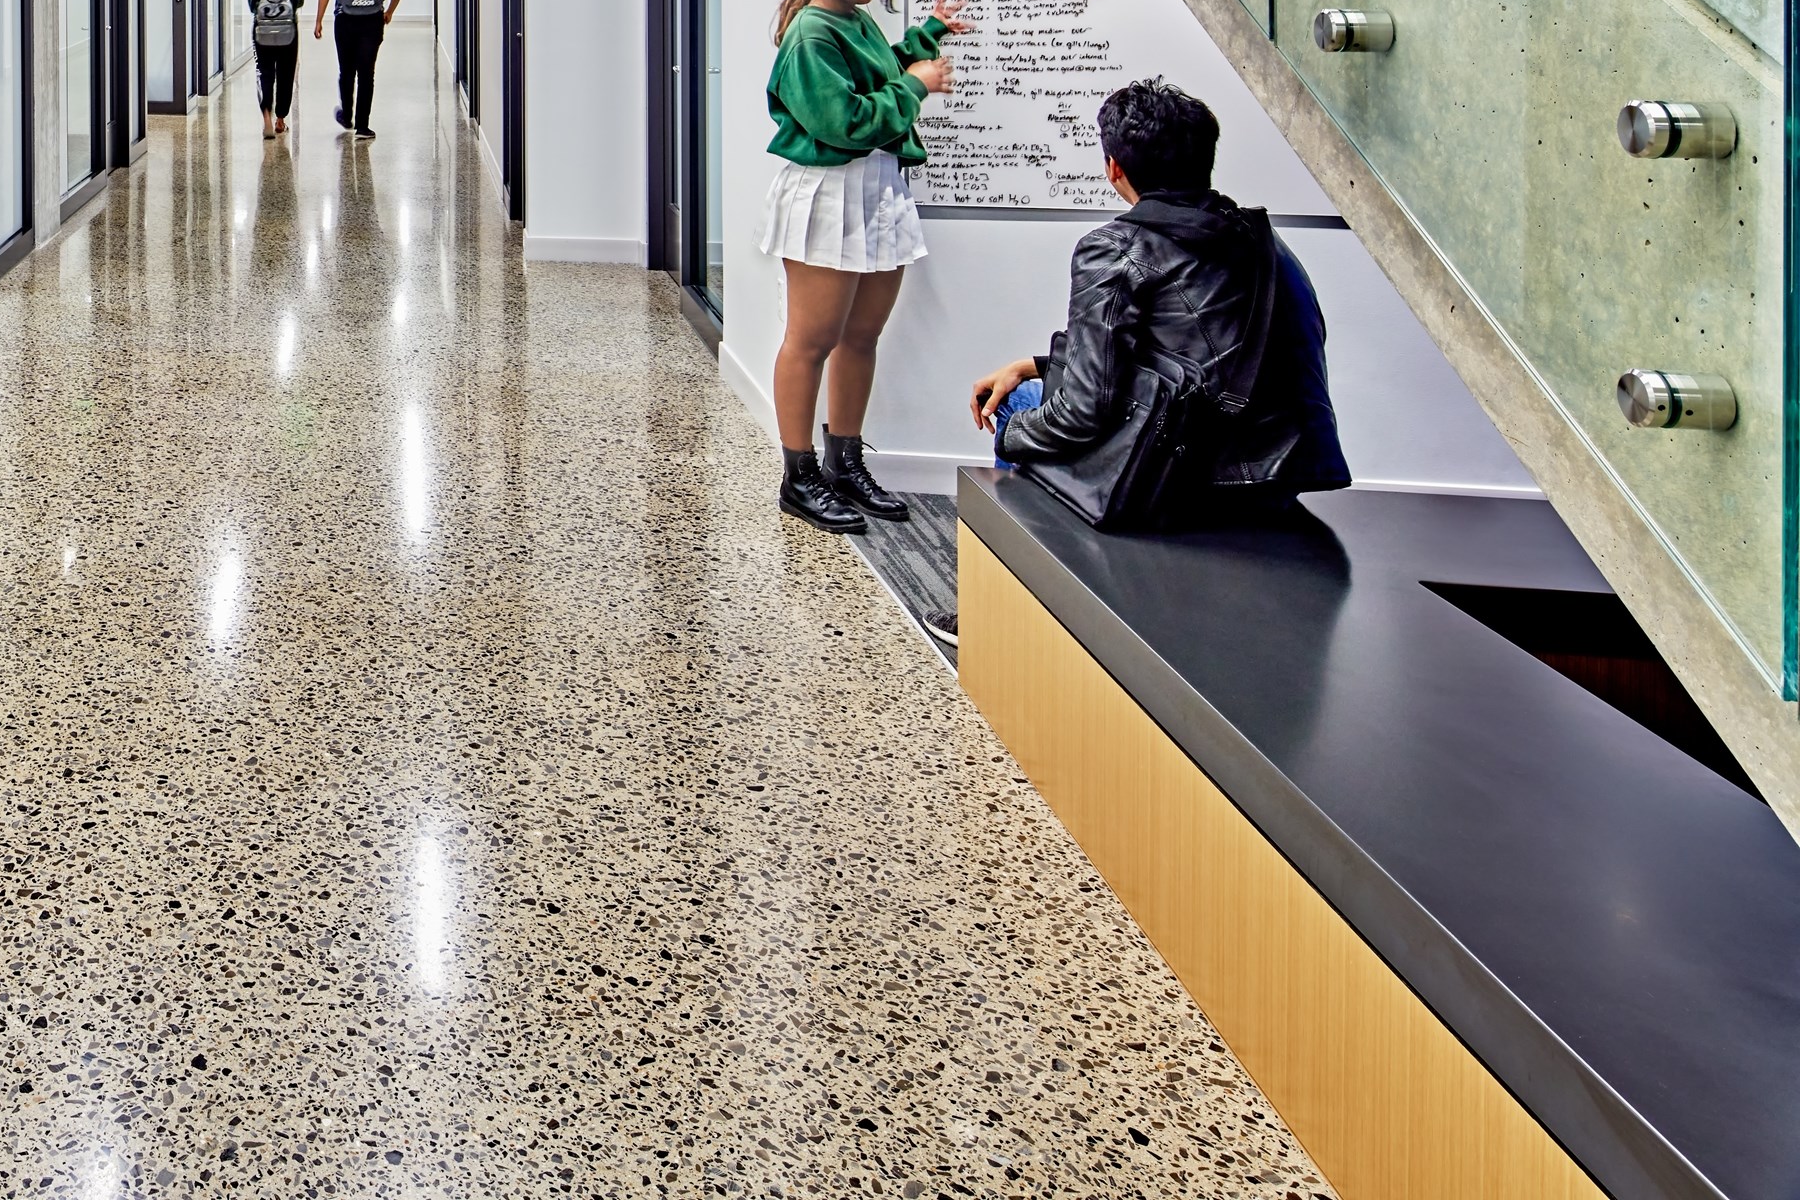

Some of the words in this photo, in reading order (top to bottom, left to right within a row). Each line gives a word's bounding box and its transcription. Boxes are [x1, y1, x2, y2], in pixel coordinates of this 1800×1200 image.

[943, 99, 978, 110] Water
[1058, 101, 1073, 109] Air
[962, 171, 990, 182] [O2]
[1063, 186, 1086, 196] Risk
[954, 192, 971, 203] hot
